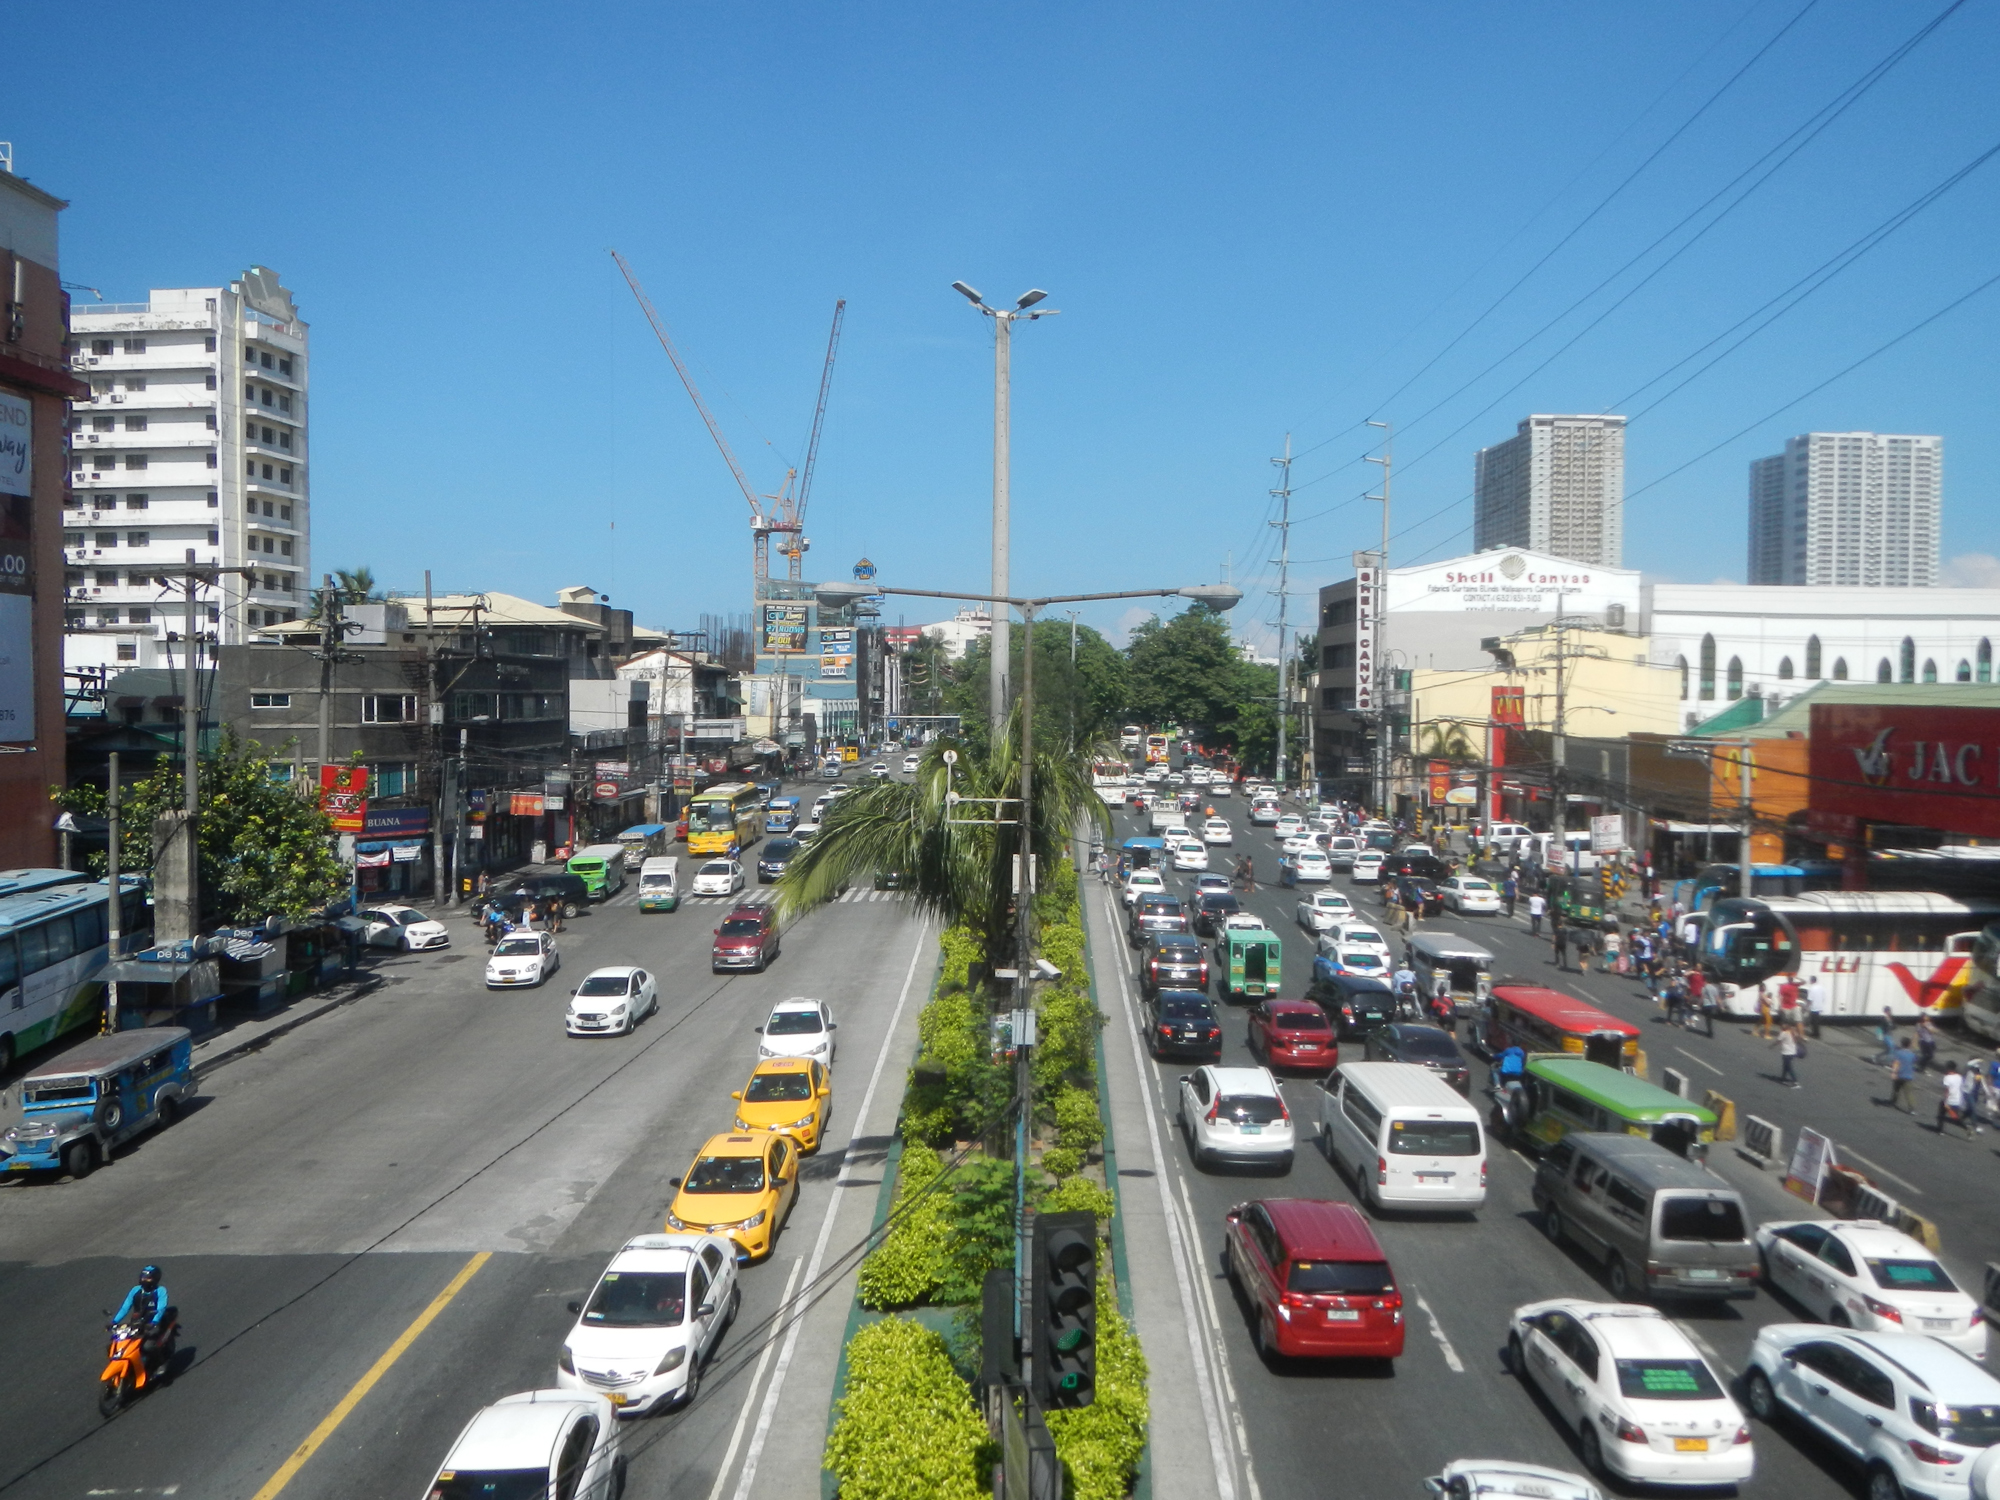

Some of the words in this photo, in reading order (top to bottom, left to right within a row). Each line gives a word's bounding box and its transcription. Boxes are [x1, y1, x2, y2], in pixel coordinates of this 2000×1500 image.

[1446, 572, 1494, 583] Shell
[1528, 572, 1590, 584] Canvas
[1360, 572, 1371, 631] SHELL
[1359, 638, 1371, 708] CANVAS
[1909, 740, 1982, 786] JAC
[367, 817, 401, 828] BUANA
